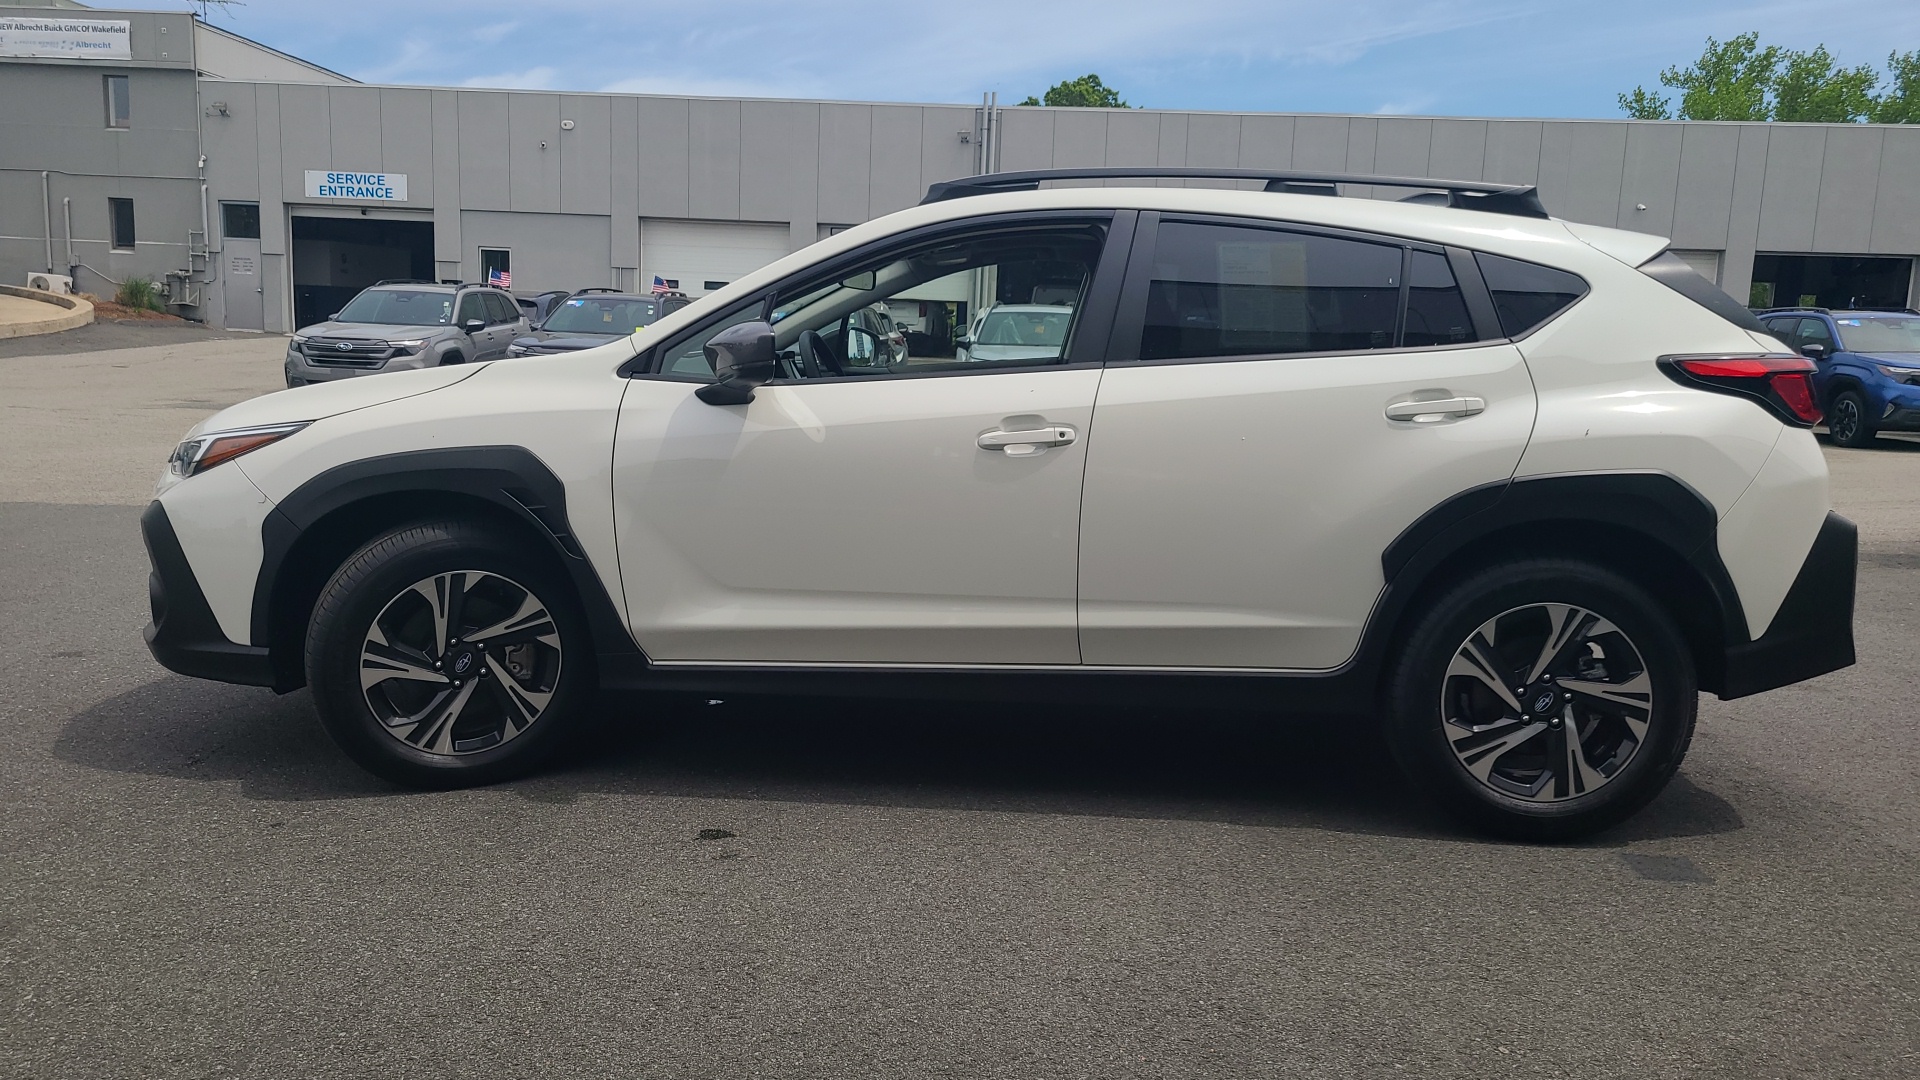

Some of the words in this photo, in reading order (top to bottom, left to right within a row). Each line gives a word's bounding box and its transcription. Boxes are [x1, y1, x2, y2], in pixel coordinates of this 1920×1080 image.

[14, 23, 43, 31] Albrecht
[44, 24, 63, 32] Buick
[91, 25, 126, 34] Wakefield
[75, 41, 112, 49] Albrecht
[327, 173, 385, 186] SERVICE
[319, 185, 393, 198] ENTRANCE
